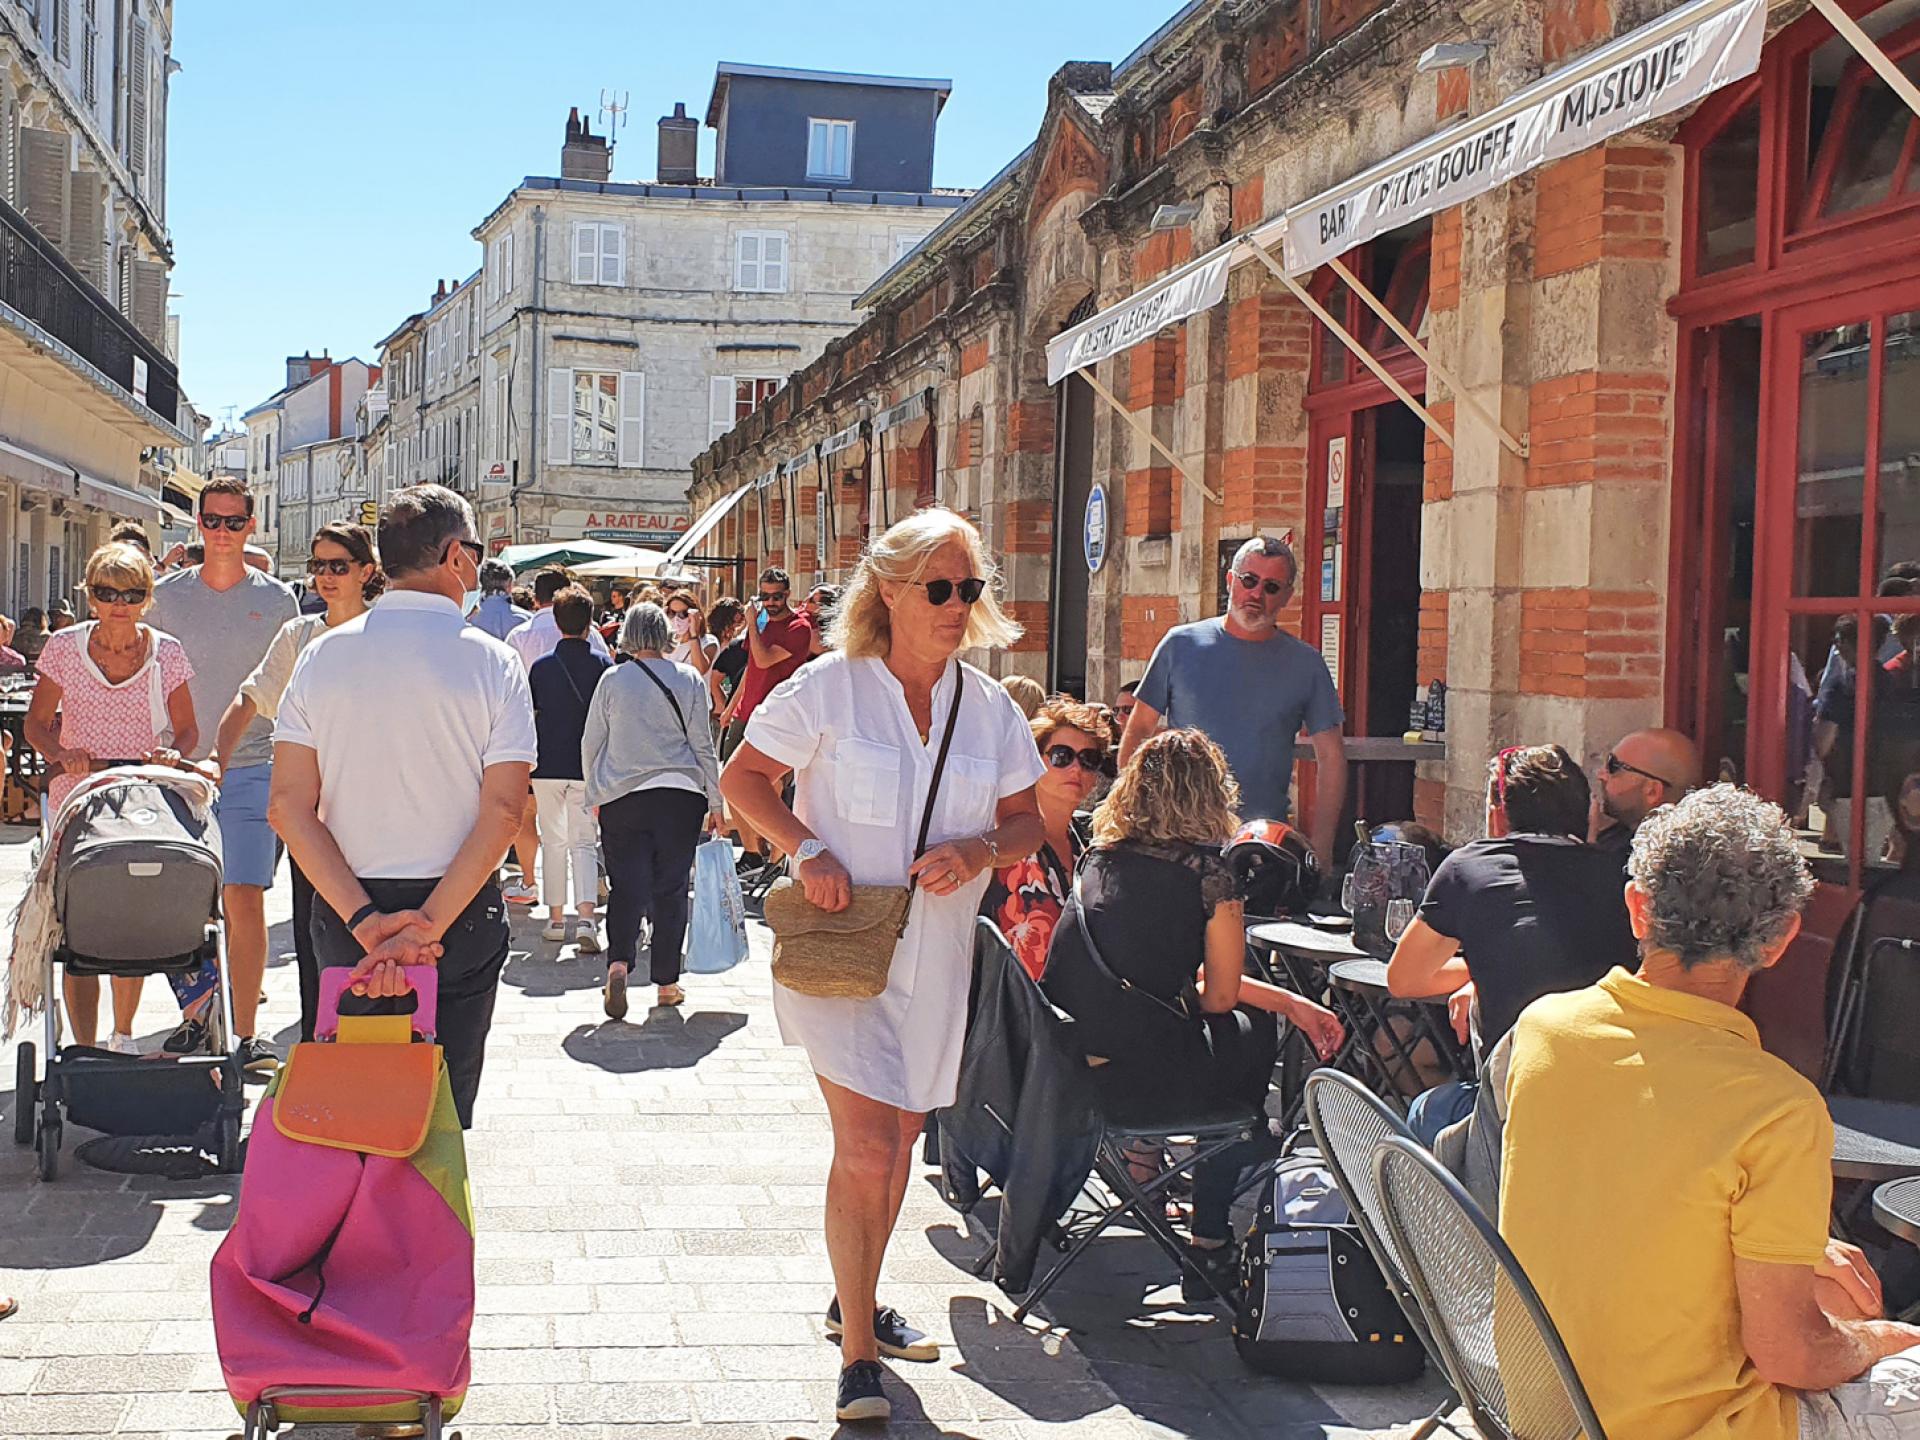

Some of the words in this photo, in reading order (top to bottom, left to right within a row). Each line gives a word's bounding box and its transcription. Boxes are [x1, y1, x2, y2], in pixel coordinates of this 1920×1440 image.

[1319, 203, 1346, 245] BAR
[1436, 120, 1516, 189] BOUFFE
[586, 513, 602, 527] A.
[605, 514, 669, 529] RATEAU
